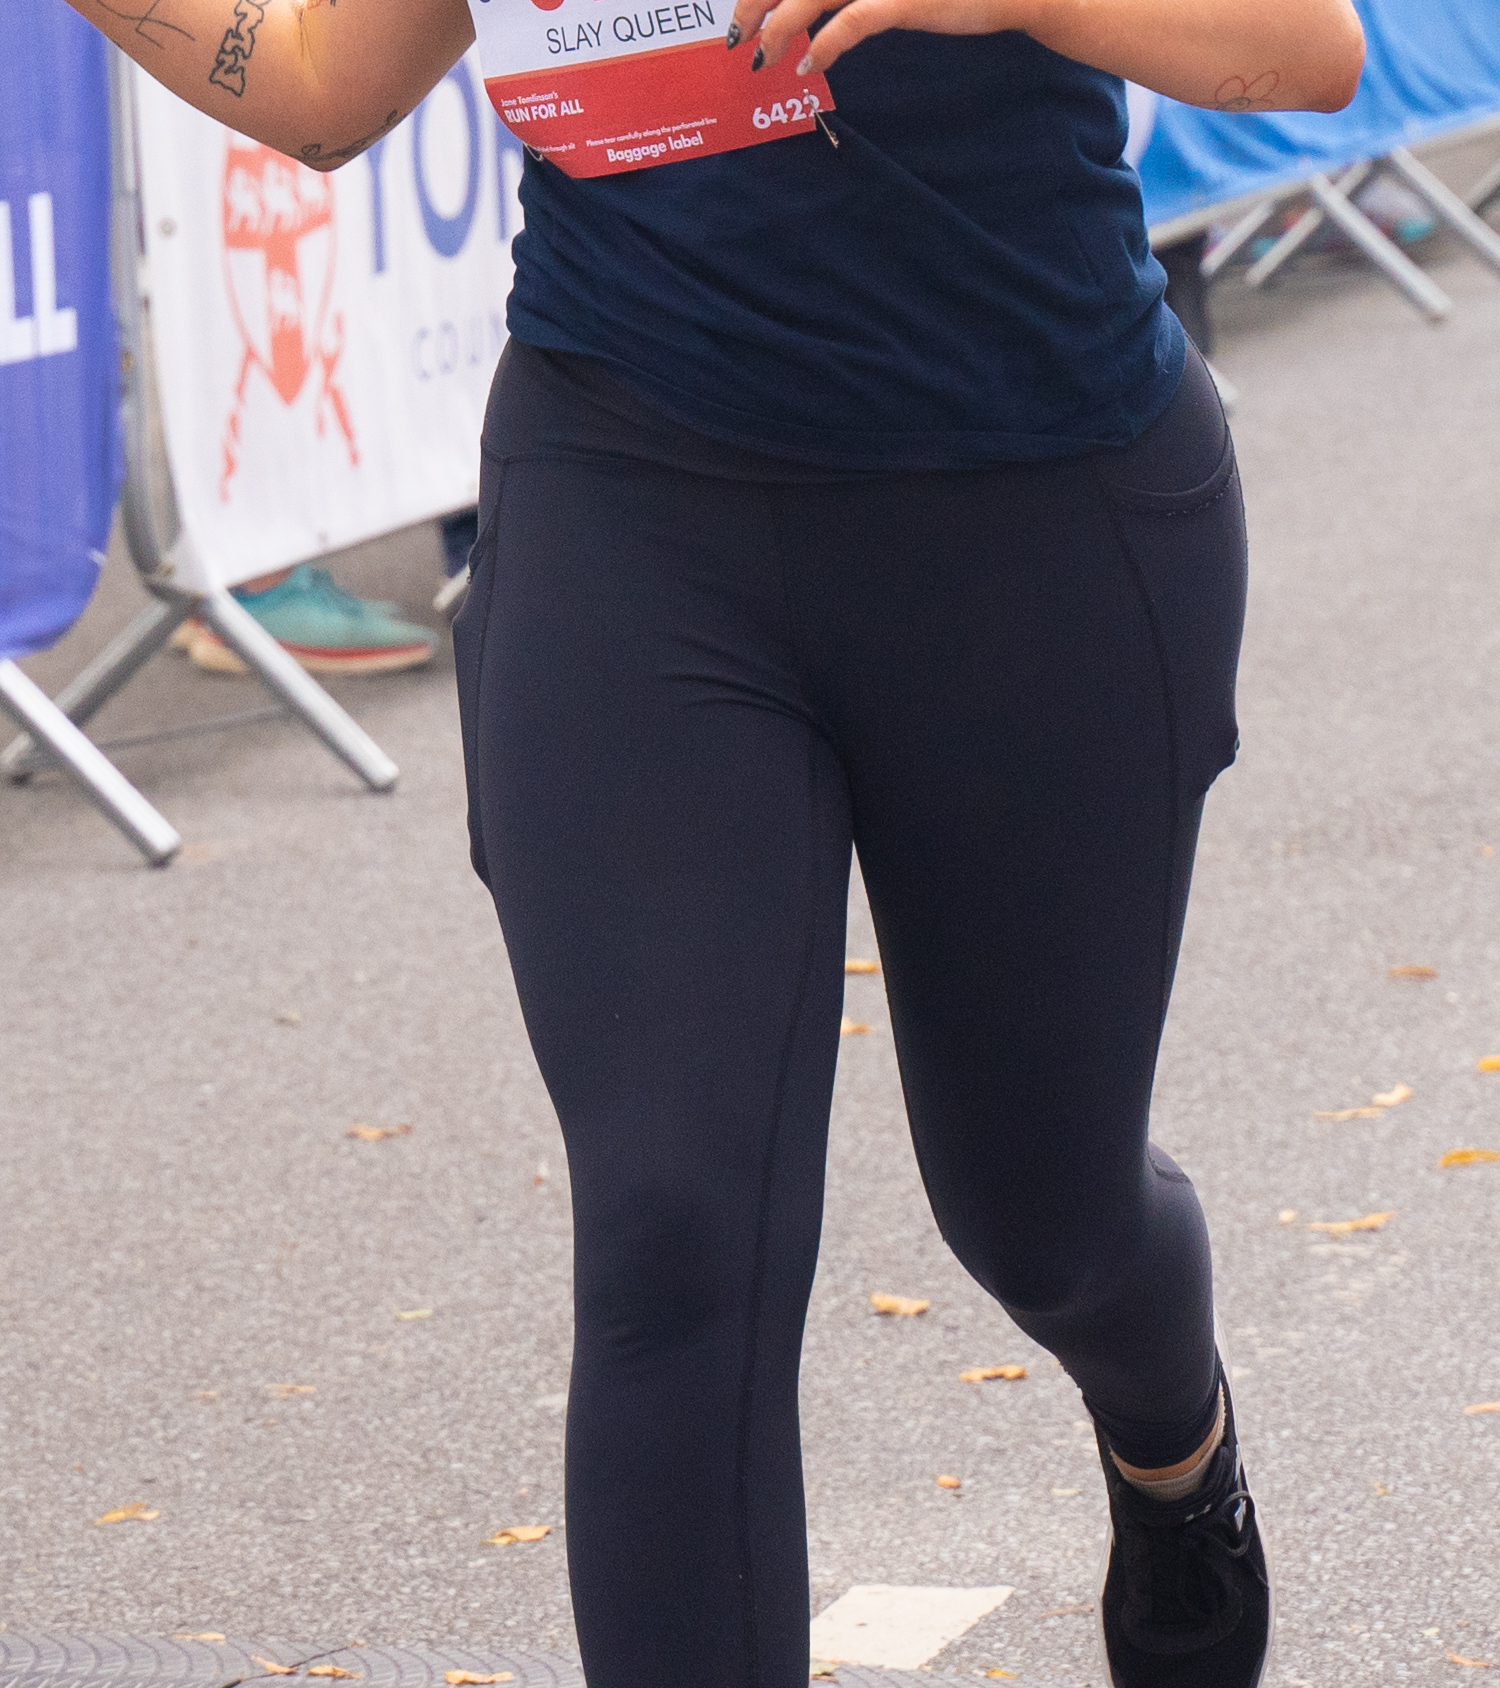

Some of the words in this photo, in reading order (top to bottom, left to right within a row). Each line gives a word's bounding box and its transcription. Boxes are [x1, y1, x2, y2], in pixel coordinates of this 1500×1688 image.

[546, 20, 603, 55] SLAY
[612, 0, 715, 42] QUEEN
[504, 107, 531, 123] RUN
[531, 103, 558, 121] FOR
[560, 98, 584, 115] ALL
[752, 94, 822, 130] 6422
[606, 143, 668, 163] Baggage
[668, 130, 704, 150] label
